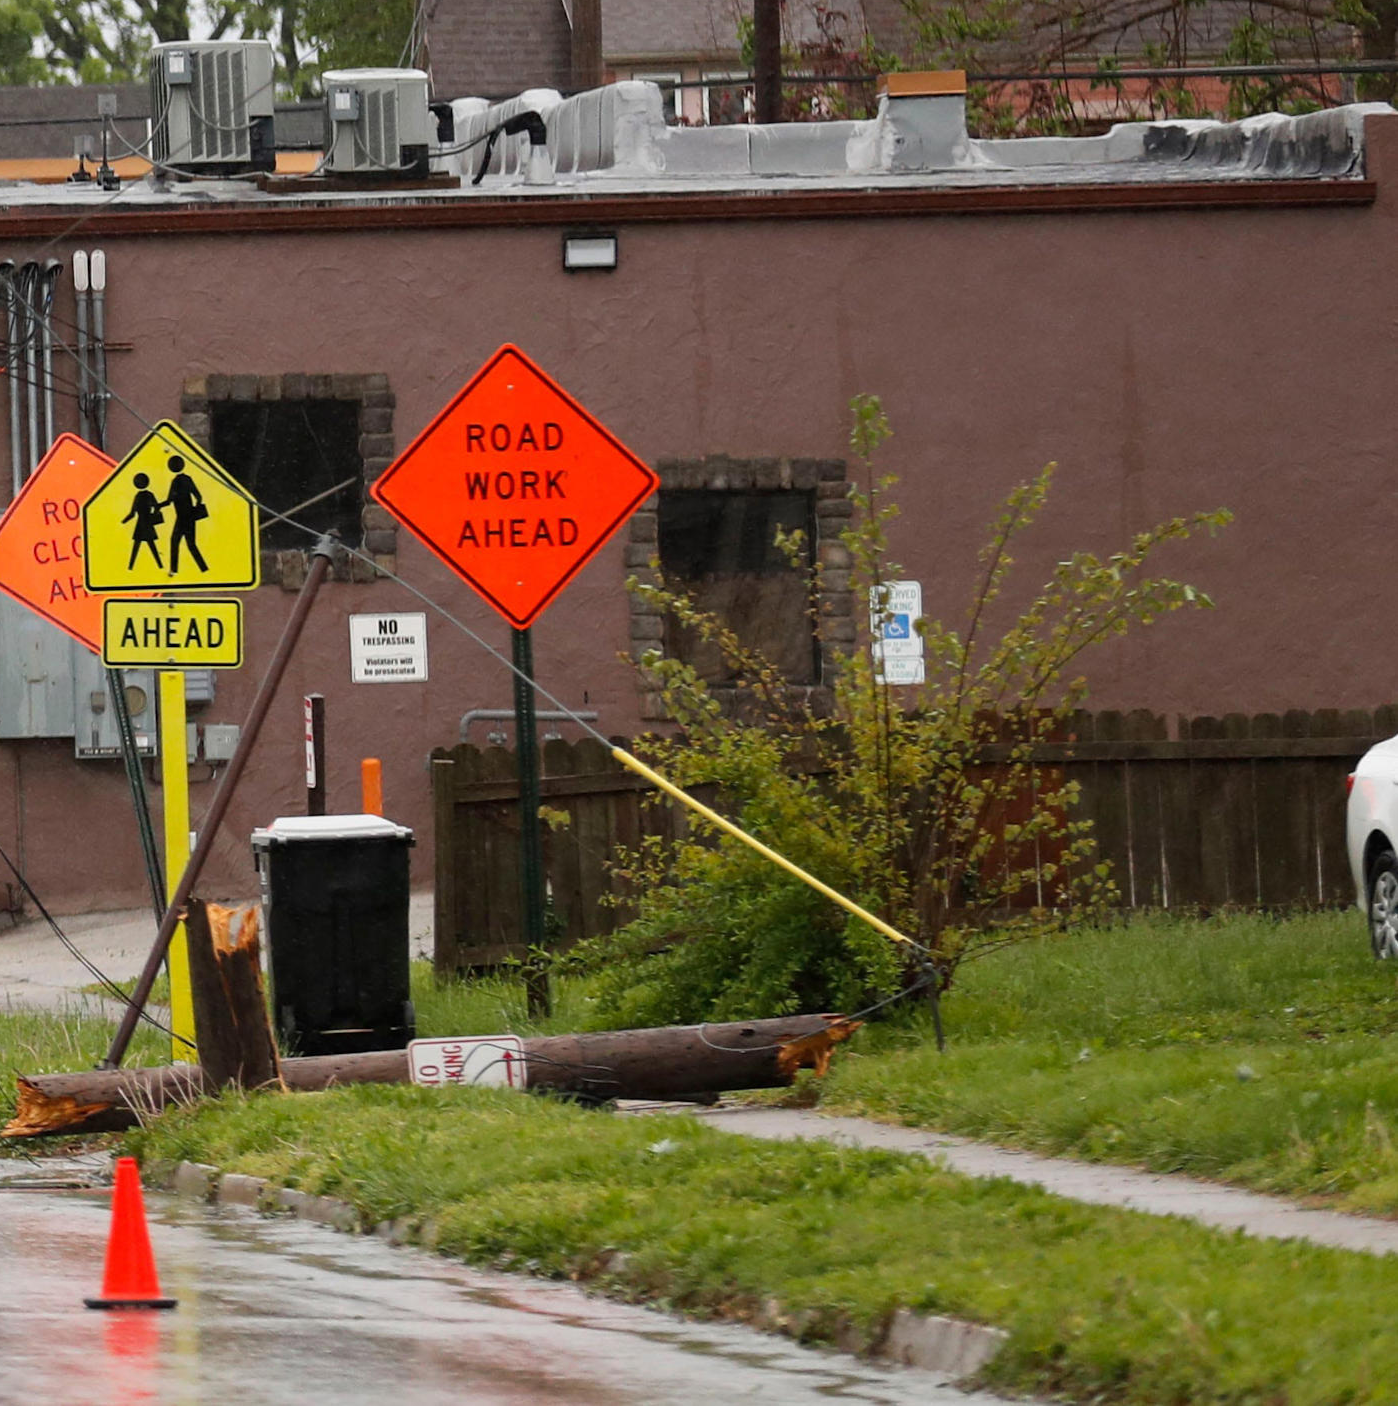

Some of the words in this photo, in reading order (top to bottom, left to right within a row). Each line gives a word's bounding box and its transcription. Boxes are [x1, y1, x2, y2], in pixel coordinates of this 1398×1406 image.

[466, 422, 564, 452] ROAD
[465, 470, 568, 500] WORK
[42, 498, 80, 525] RO
[457, 518, 579, 548] AHEAD
[33, 535, 82, 565] CLO
[121, 617, 224, 648] AHEAD
[363, 636, 416, 646] TRESPASSING
[378, 619, 398, 635] NO
[366, 658, 398, 666] Violators
[400, 657, 413, 665] will
[374, 666, 416, 676] prosecuted
